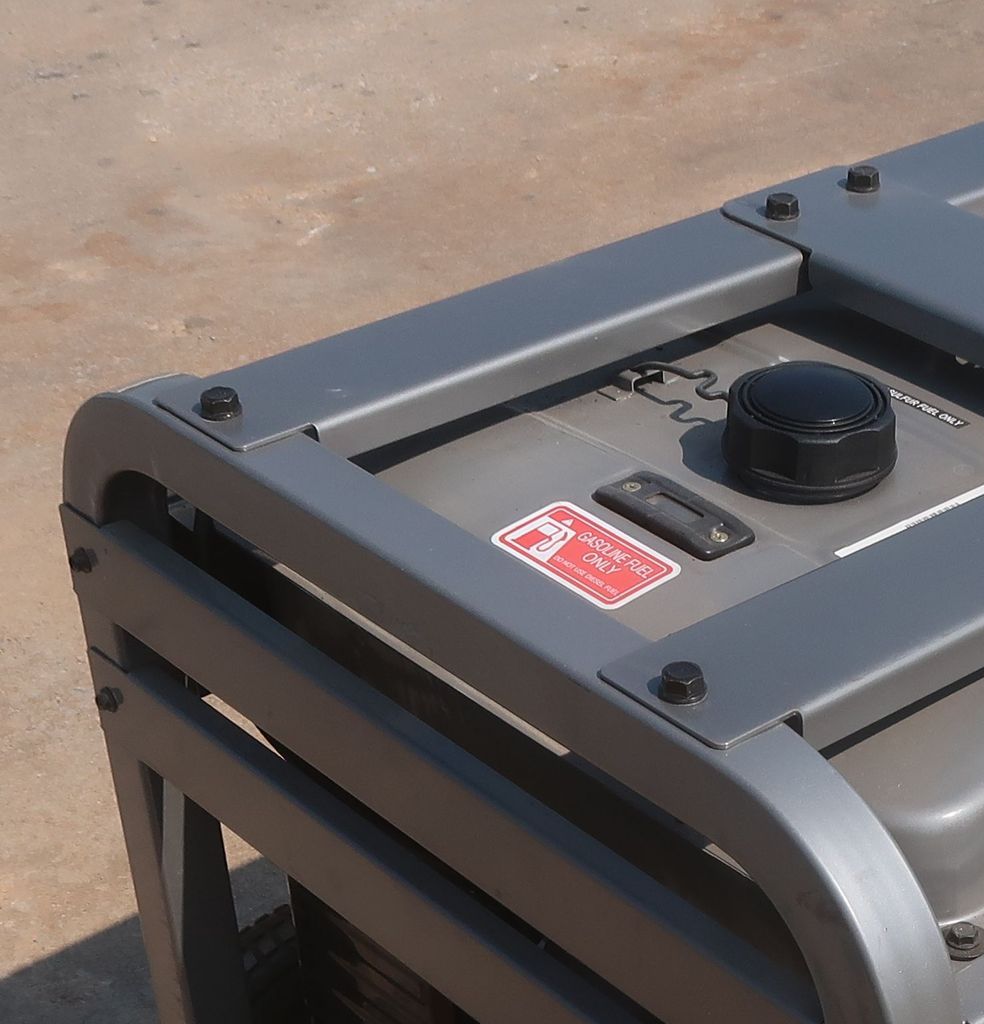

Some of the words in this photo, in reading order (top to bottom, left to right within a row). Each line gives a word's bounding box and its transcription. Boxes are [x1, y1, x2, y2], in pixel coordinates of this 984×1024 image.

[917, 402, 940, 417] FUEL
[938, 412, 965, 427] ONLY
[577, 531, 630, 563] GASOLINE
[624, 557, 655, 579] FUEL
[582, 551, 623, 575] ONLY
[553, 555, 565, 564] DO
[563, 558, 575, 569] NOT
[574, 566, 586, 577] USE
[584, 572, 605, 588] DIESEL
[604, 583, 619, 596] FUEL
